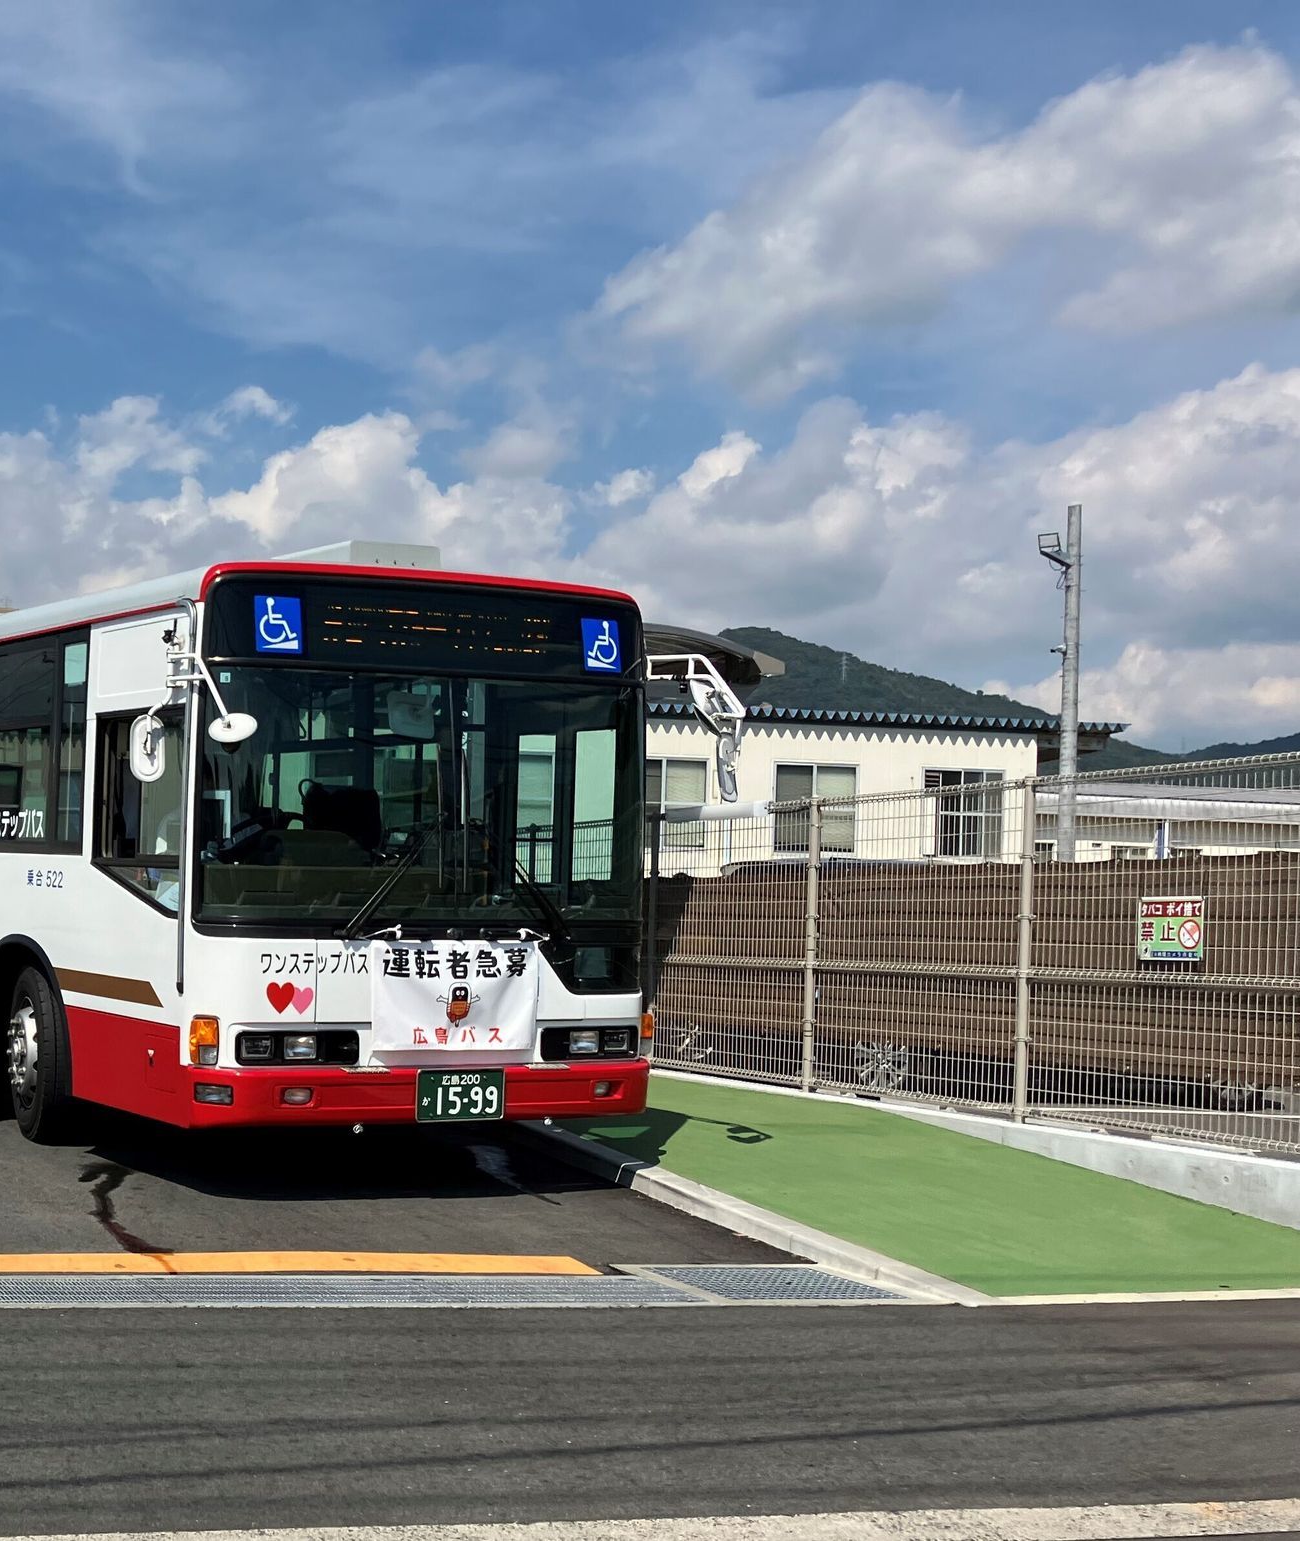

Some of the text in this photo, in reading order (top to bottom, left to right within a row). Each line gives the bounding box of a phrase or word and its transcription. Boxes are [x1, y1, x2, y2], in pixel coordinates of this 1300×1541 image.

[46, 870, 63, 888] 522
[1141, 903, 1163, 916] タバコ
[1141, 920, 1175, 941] 禁止
[260, 951, 369, 975] ワンステップバス
[382, 948, 528, 979] 運転者急募
[413, 1026, 503, 1045] 広島バス
[441, 1074, 480, 1085] 広島200
[436, 1085, 499, 1116] 15-99
